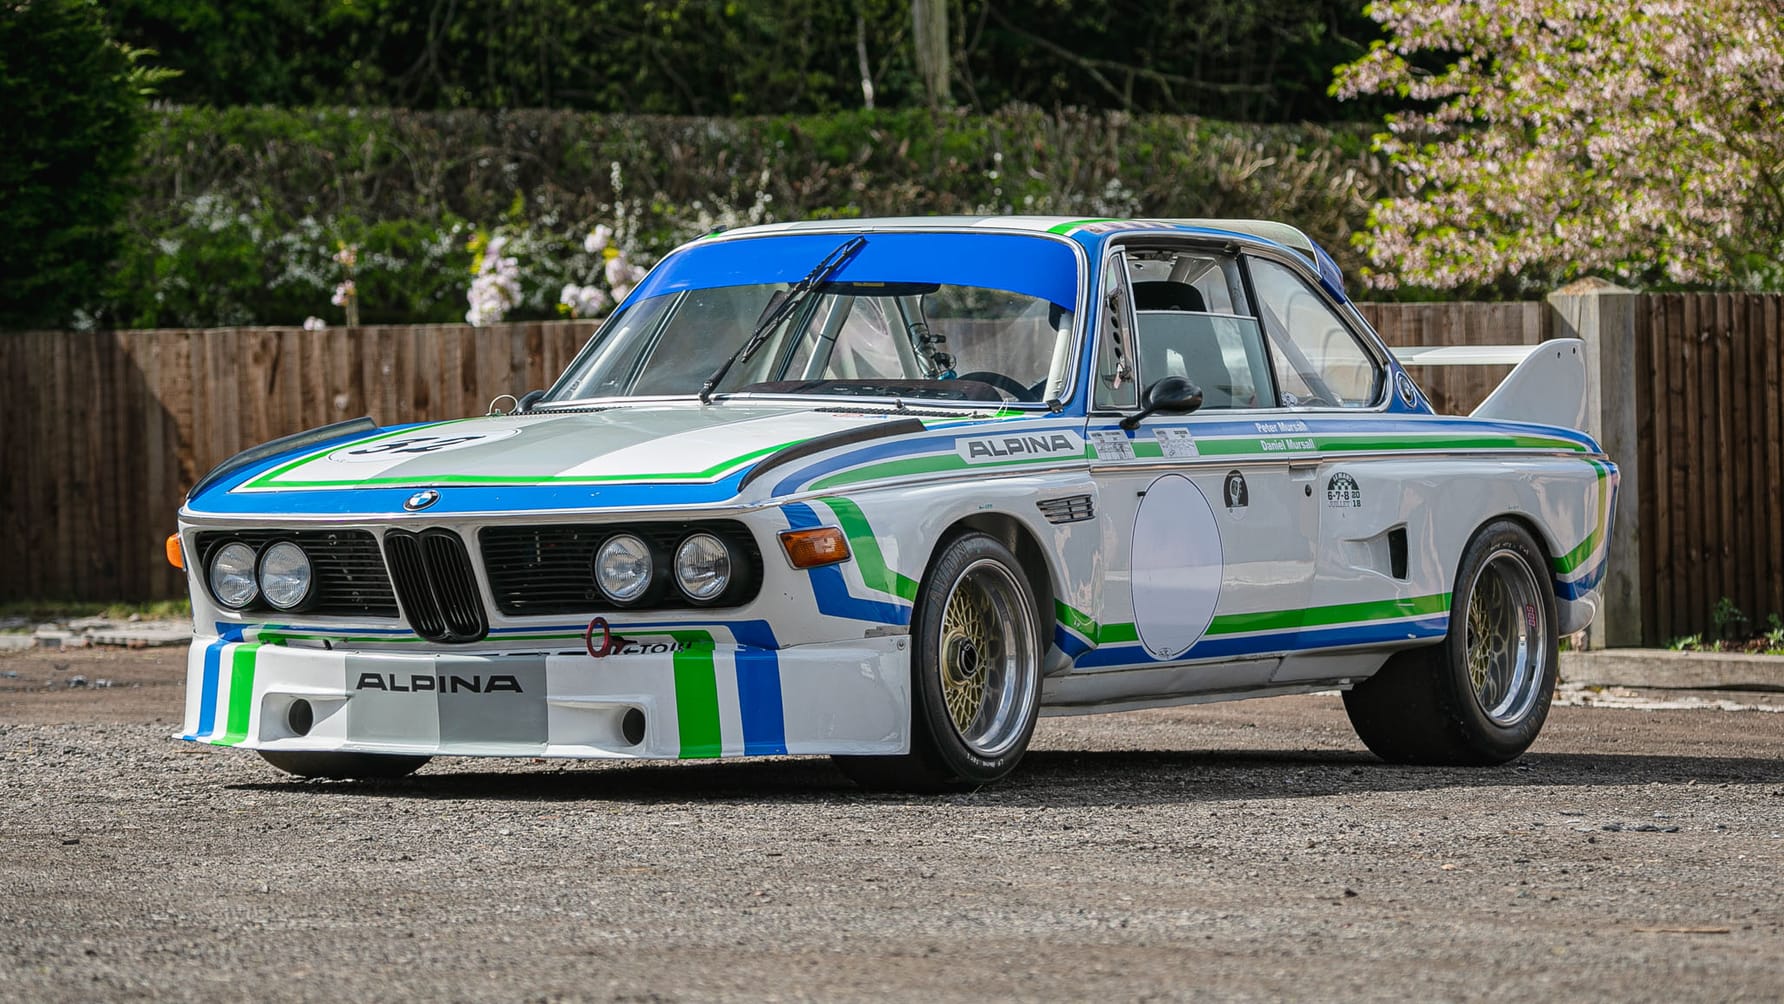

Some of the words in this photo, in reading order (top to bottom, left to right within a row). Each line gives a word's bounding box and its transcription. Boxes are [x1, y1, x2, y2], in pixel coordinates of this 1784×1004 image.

[1255, 422, 1277, 432] Peter
[1277, 420, 1308, 432] Mursall
[968, 434, 1074, 458] ALPINA
[1260, 439, 1286, 450] Daniel
[1286, 438, 1316, 450] Mursall
[1352, 491, 1360, 499] 20
[356, 673, 523, 693] ALPINA
